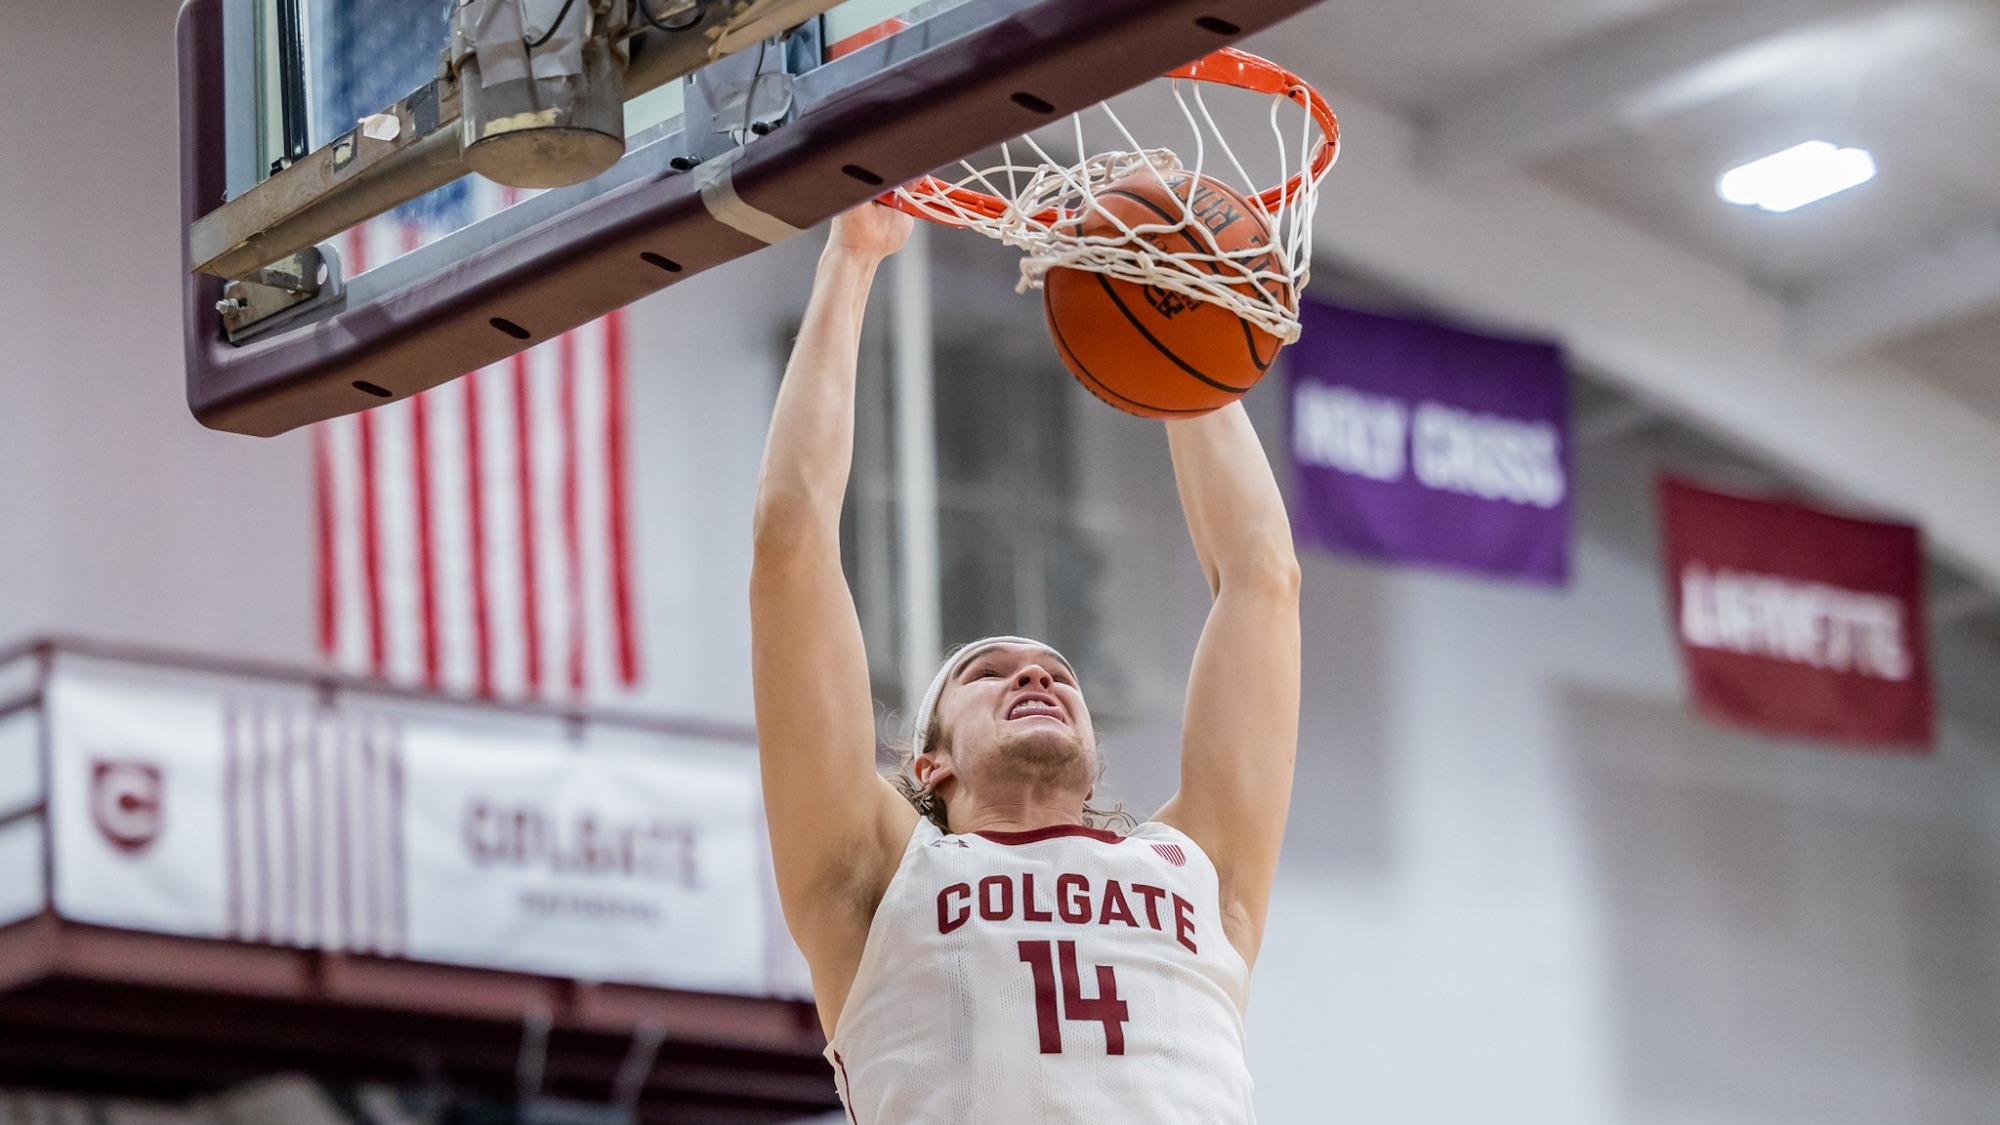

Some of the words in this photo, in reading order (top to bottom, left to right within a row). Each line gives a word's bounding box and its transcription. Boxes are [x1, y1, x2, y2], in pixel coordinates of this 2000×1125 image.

[1294, 380, 1405, 481] HOLY
[1412, 401, 1565, 506] CROSS
[462, 799, 704, 891] COLGATE
[937, 873, 1198, 954] COLGATE
[1018, 940, 1129, 1055] 14
